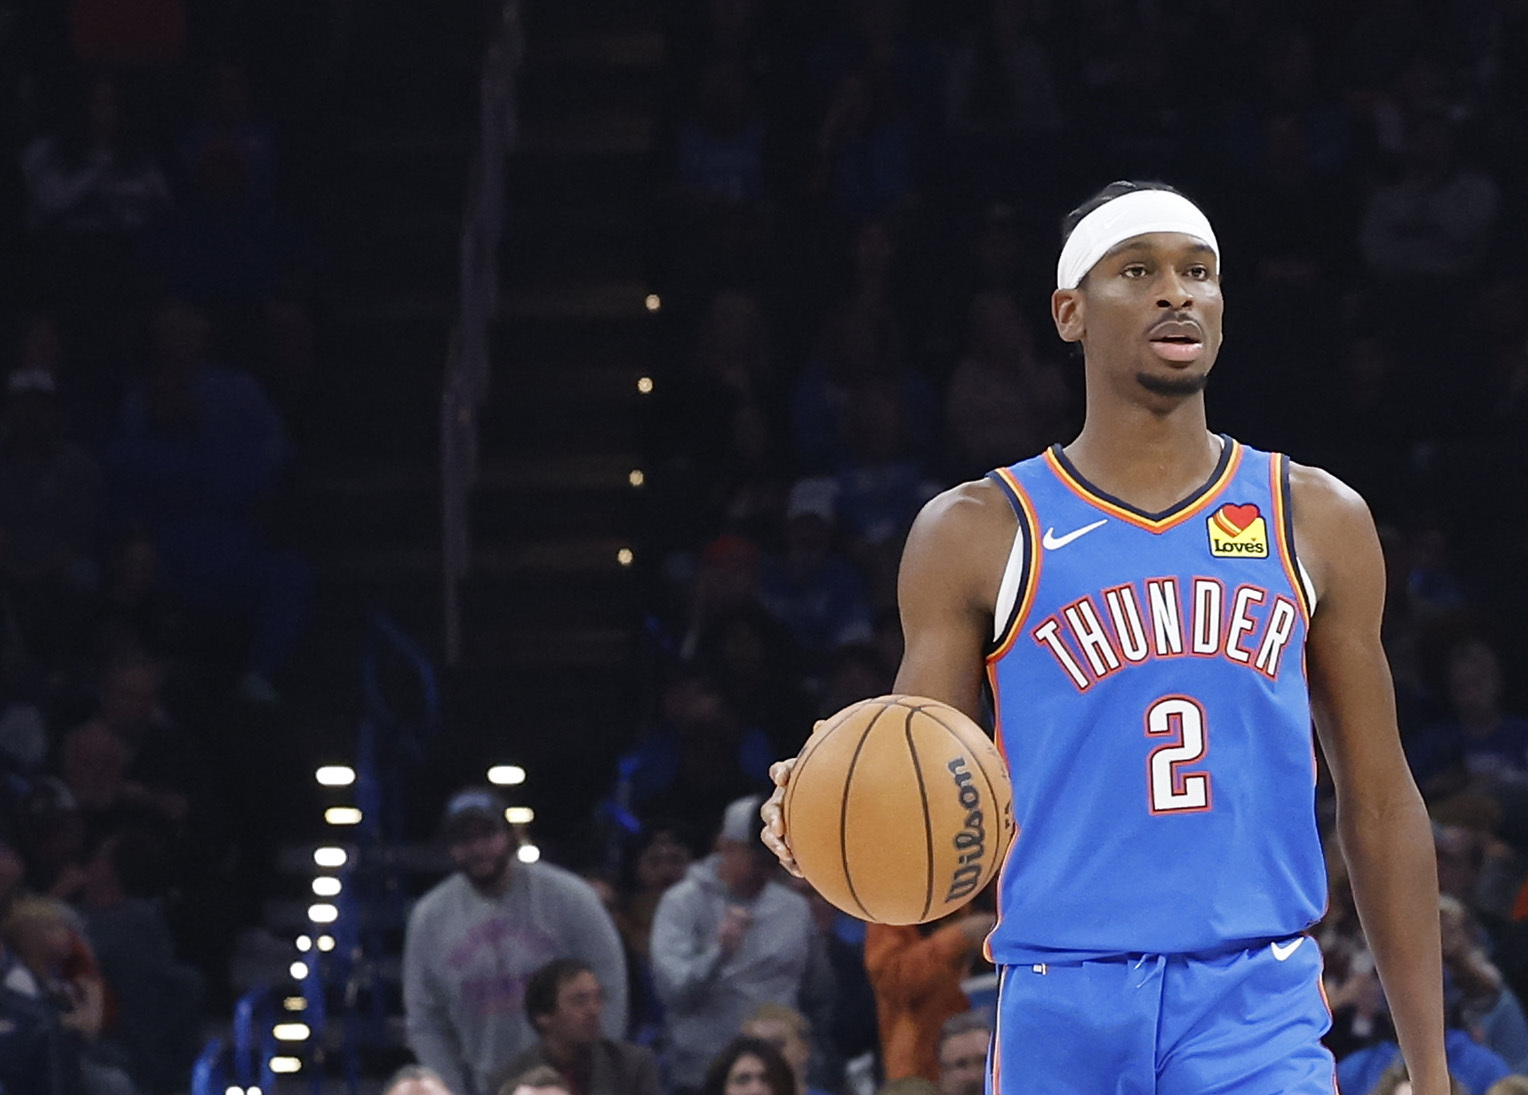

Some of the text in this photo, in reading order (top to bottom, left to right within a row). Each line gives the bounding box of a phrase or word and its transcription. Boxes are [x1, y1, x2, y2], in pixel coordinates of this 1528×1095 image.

[1033, 577, 1299, 692] THUNDER
[1145, 695, 1212, 815] 2
[945, 756, 985, 903] Wilson
